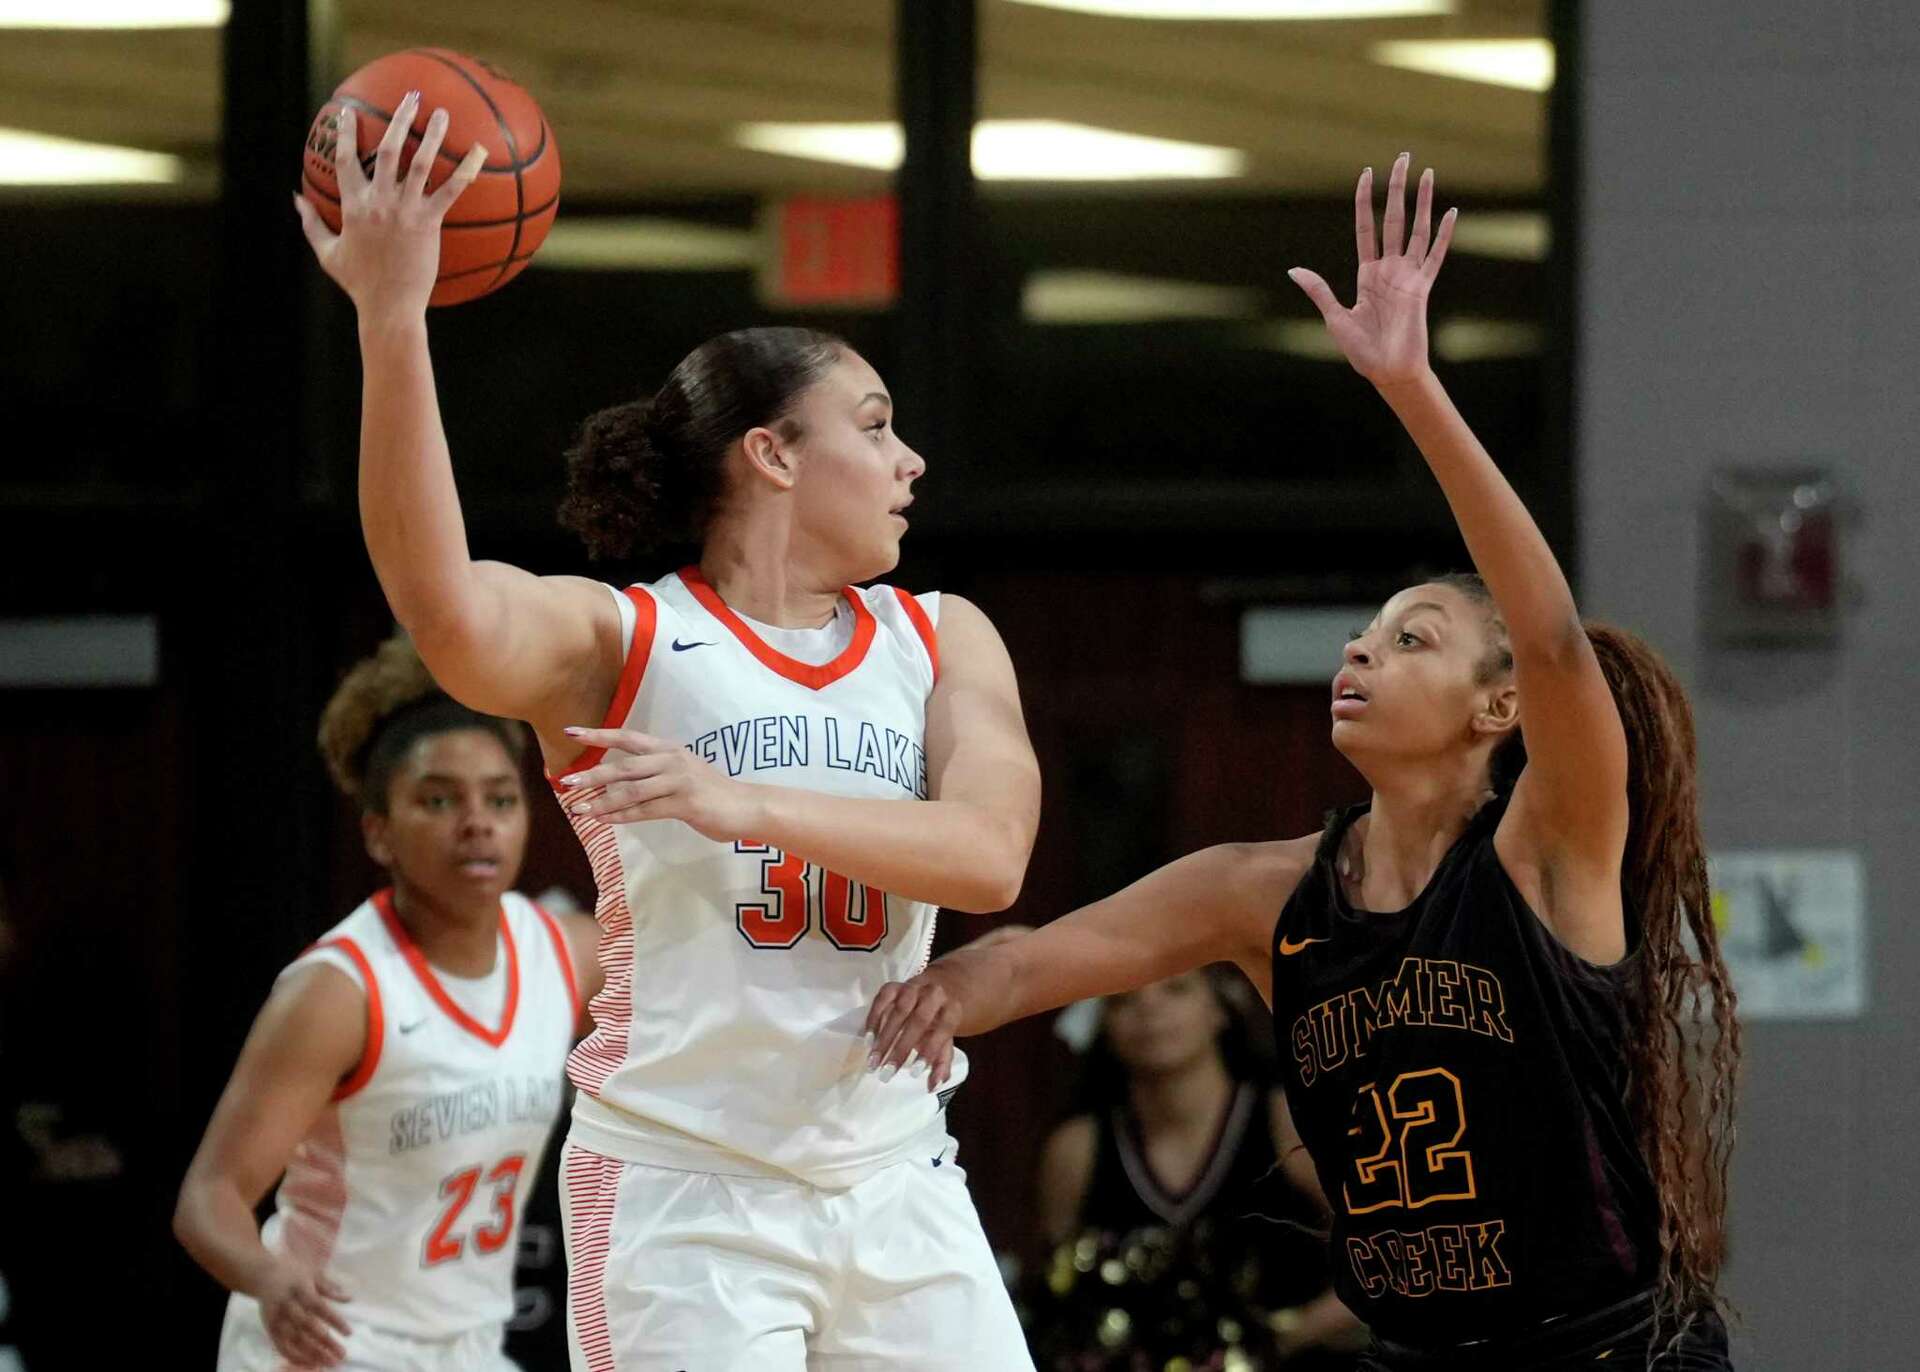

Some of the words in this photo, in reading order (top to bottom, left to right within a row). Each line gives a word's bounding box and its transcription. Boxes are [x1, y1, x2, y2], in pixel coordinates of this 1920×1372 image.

[684, 715, 808, 777] EVEN
[735, 840, 888, 951] 30
[1292, 957, 1514, 1087] SUMMER
[390, 1080, 499, 1154] SEVEN
[1344, 1067, 1476, 1215] 22
[420, 1152, 526, 1269] 23
